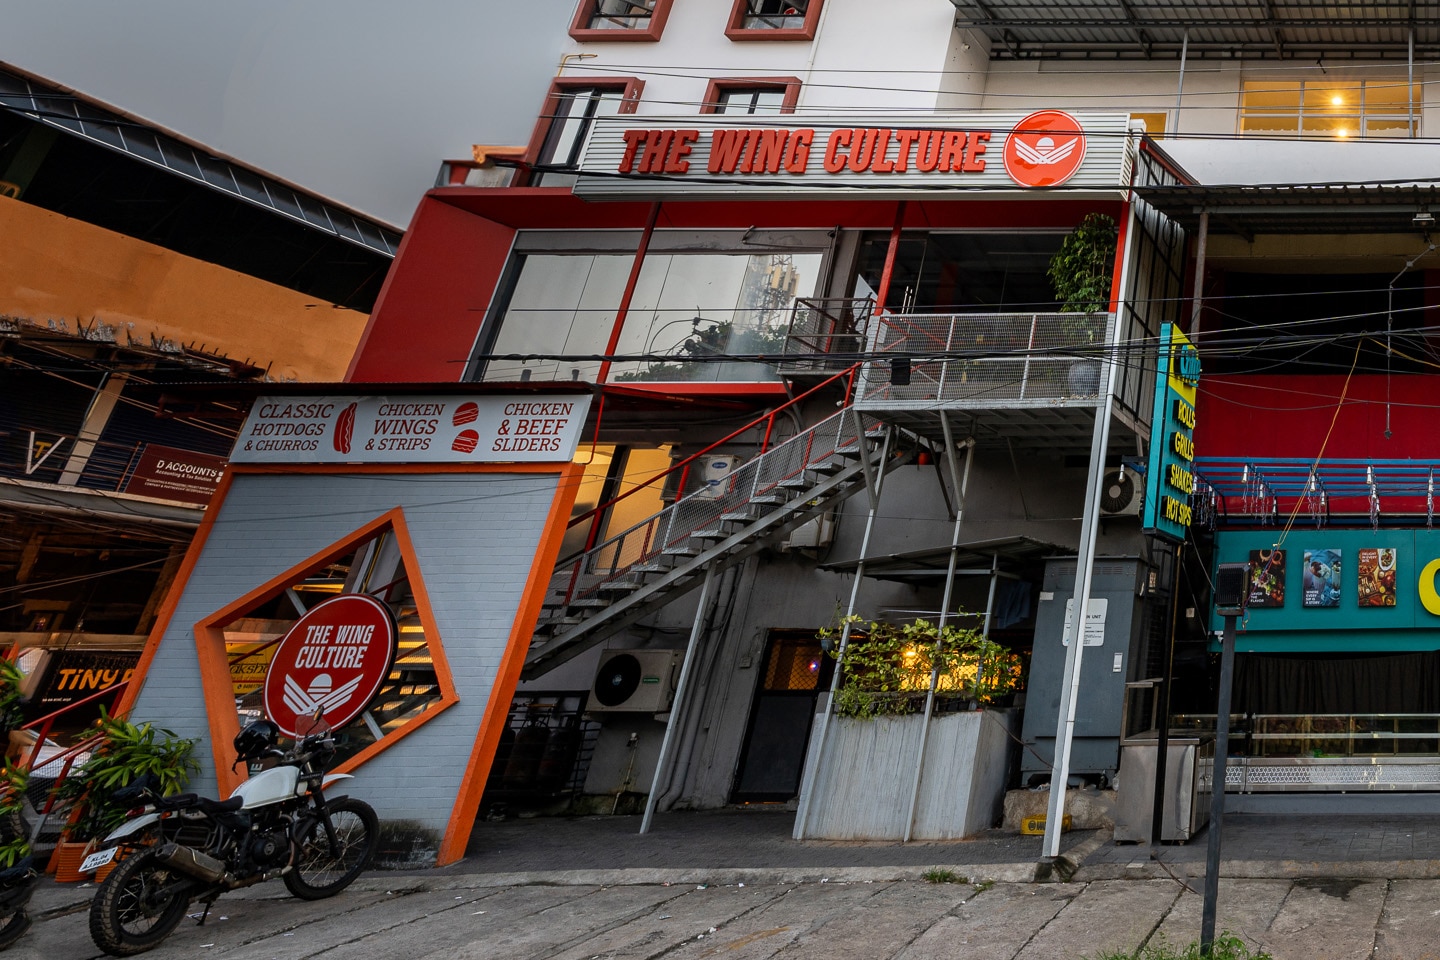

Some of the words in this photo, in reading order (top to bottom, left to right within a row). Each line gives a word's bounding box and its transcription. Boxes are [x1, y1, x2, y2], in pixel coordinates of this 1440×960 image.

[618, 129, 699, 174] THE
[707, 129, 815, 175] WING
[822, 129, 991, 174] CULTURE
[259, 404, 335, 418] CLASSIC
[378, 404, 445, 416] CHICKEN
[504, 403, 574, 415] CHICKEN
[1178, 400, 1195, 430] ROLLS
[250, 423, 326, 436] HOTDOGS
[373, 419, 439, 435] WINGS
[497, 419, 511, 435] &
[514, 419, 568, 435] BEEF
[244, 441, 253, 451] &
[255, 440, 319, 451] CHURROS
[364, 438, 375, 450] &
[377, 438, 431, 450] STRIPS
[492, 438, 561, 452] SLIDERS
[1174, 431, 1194, 462] GRILLS
[165, 461, 218, 477] ACCOUNTS
[1170, 463, 1193, 495] SHAKES
[1165, 495, 1179, 524] HOT
[1178, 500, 1191, 527] SIPS
[304, 625, 333, 644] THE
[335, 625, 375, 644] WING
[295, 646, 367, 669] CULTURE
